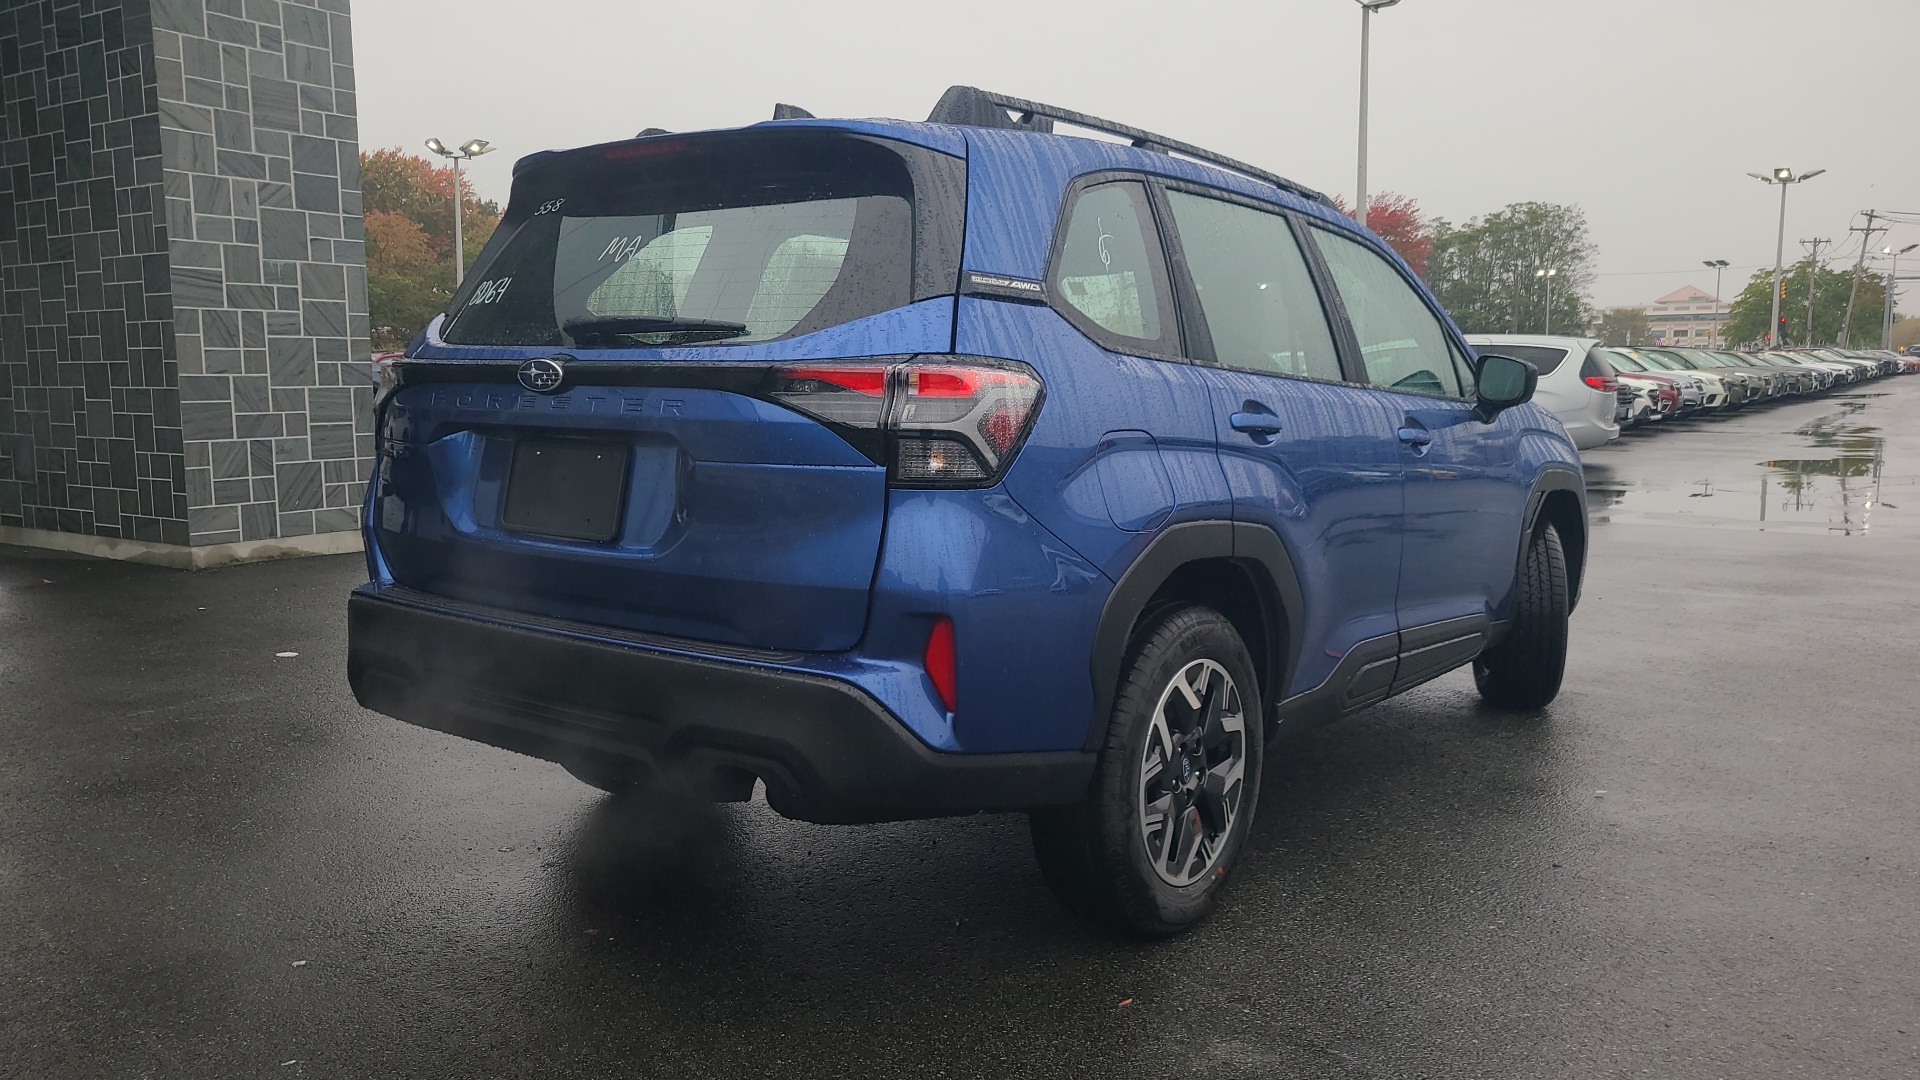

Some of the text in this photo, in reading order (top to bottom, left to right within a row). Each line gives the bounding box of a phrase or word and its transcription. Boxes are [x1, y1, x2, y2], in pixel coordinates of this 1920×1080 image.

[534, 198, 566, 216] 558
[1010, 281, 1041, 291] AWD
[430, 391, 686, 416] FORESTER
